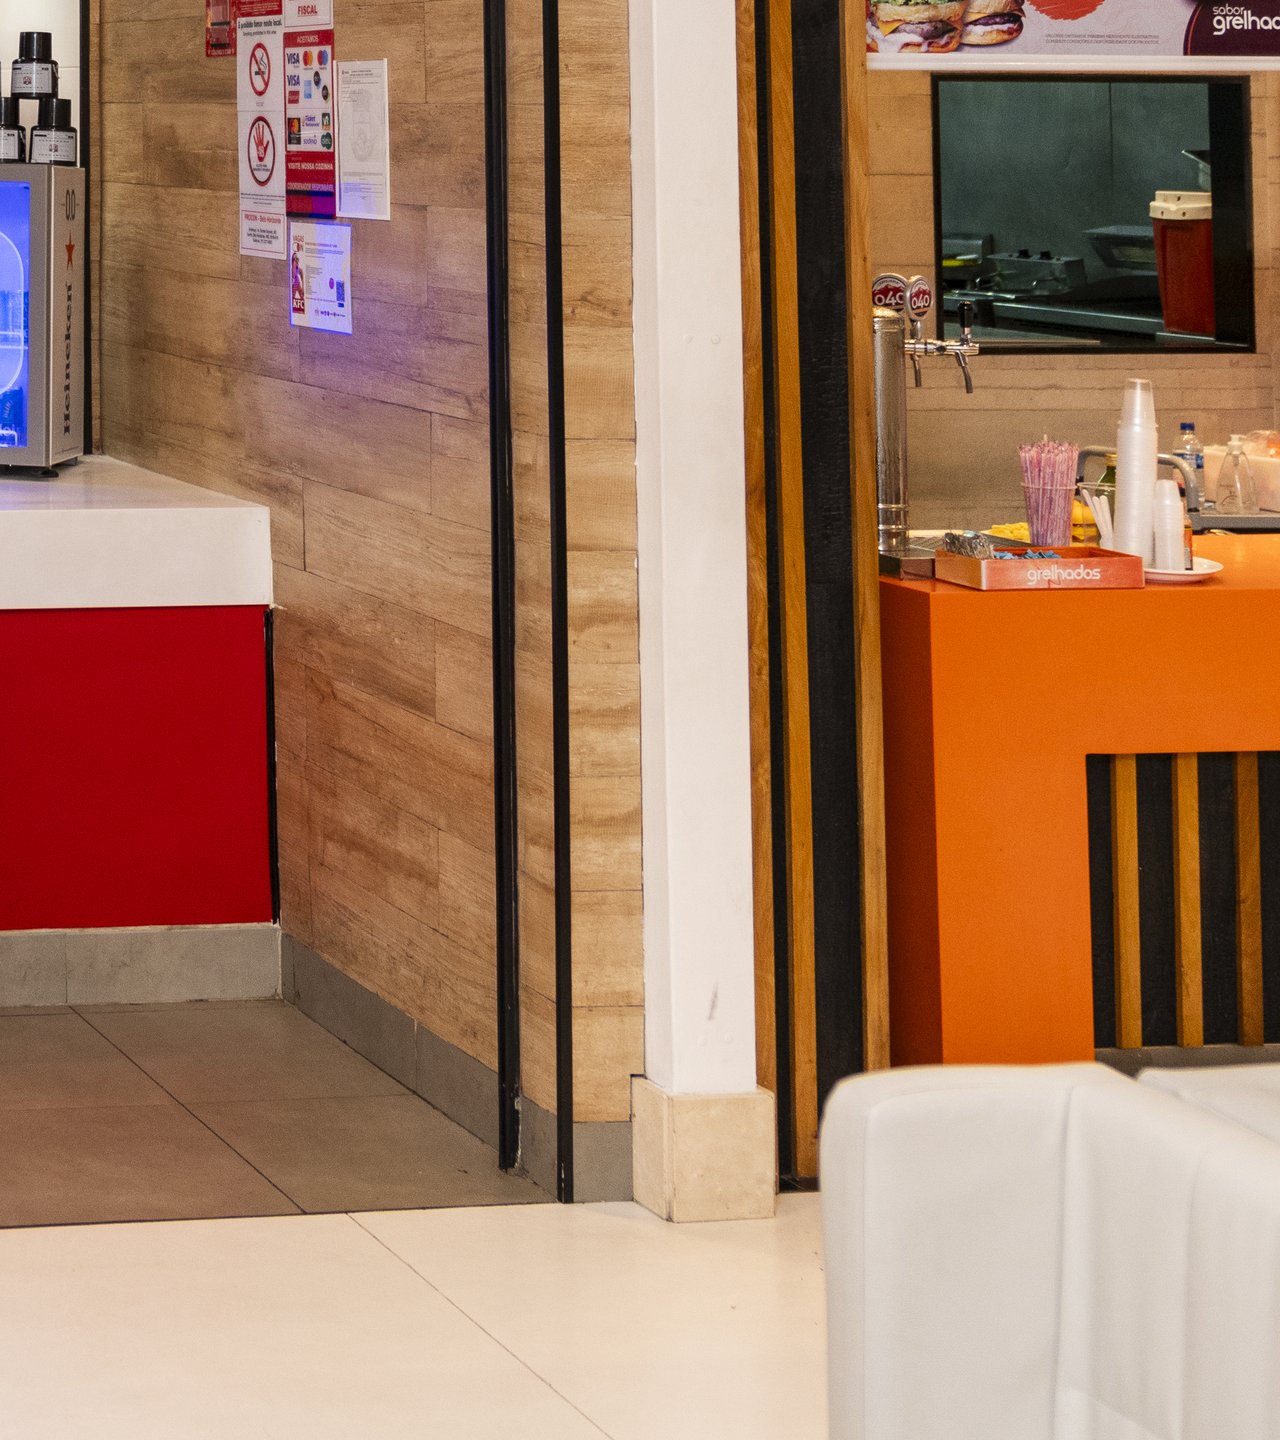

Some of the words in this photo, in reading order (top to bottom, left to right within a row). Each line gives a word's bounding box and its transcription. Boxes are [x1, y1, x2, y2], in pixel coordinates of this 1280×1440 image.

[298, 5, 318, 15] FISCAL
[1213, 3, 1244, 15] sabor
[287, 53, 300, 64] VISA
[912, 294, 929, 308] 040
[64, 281, 72, 436] Heineken
[1027, 564, 1101, 586] grelhados
